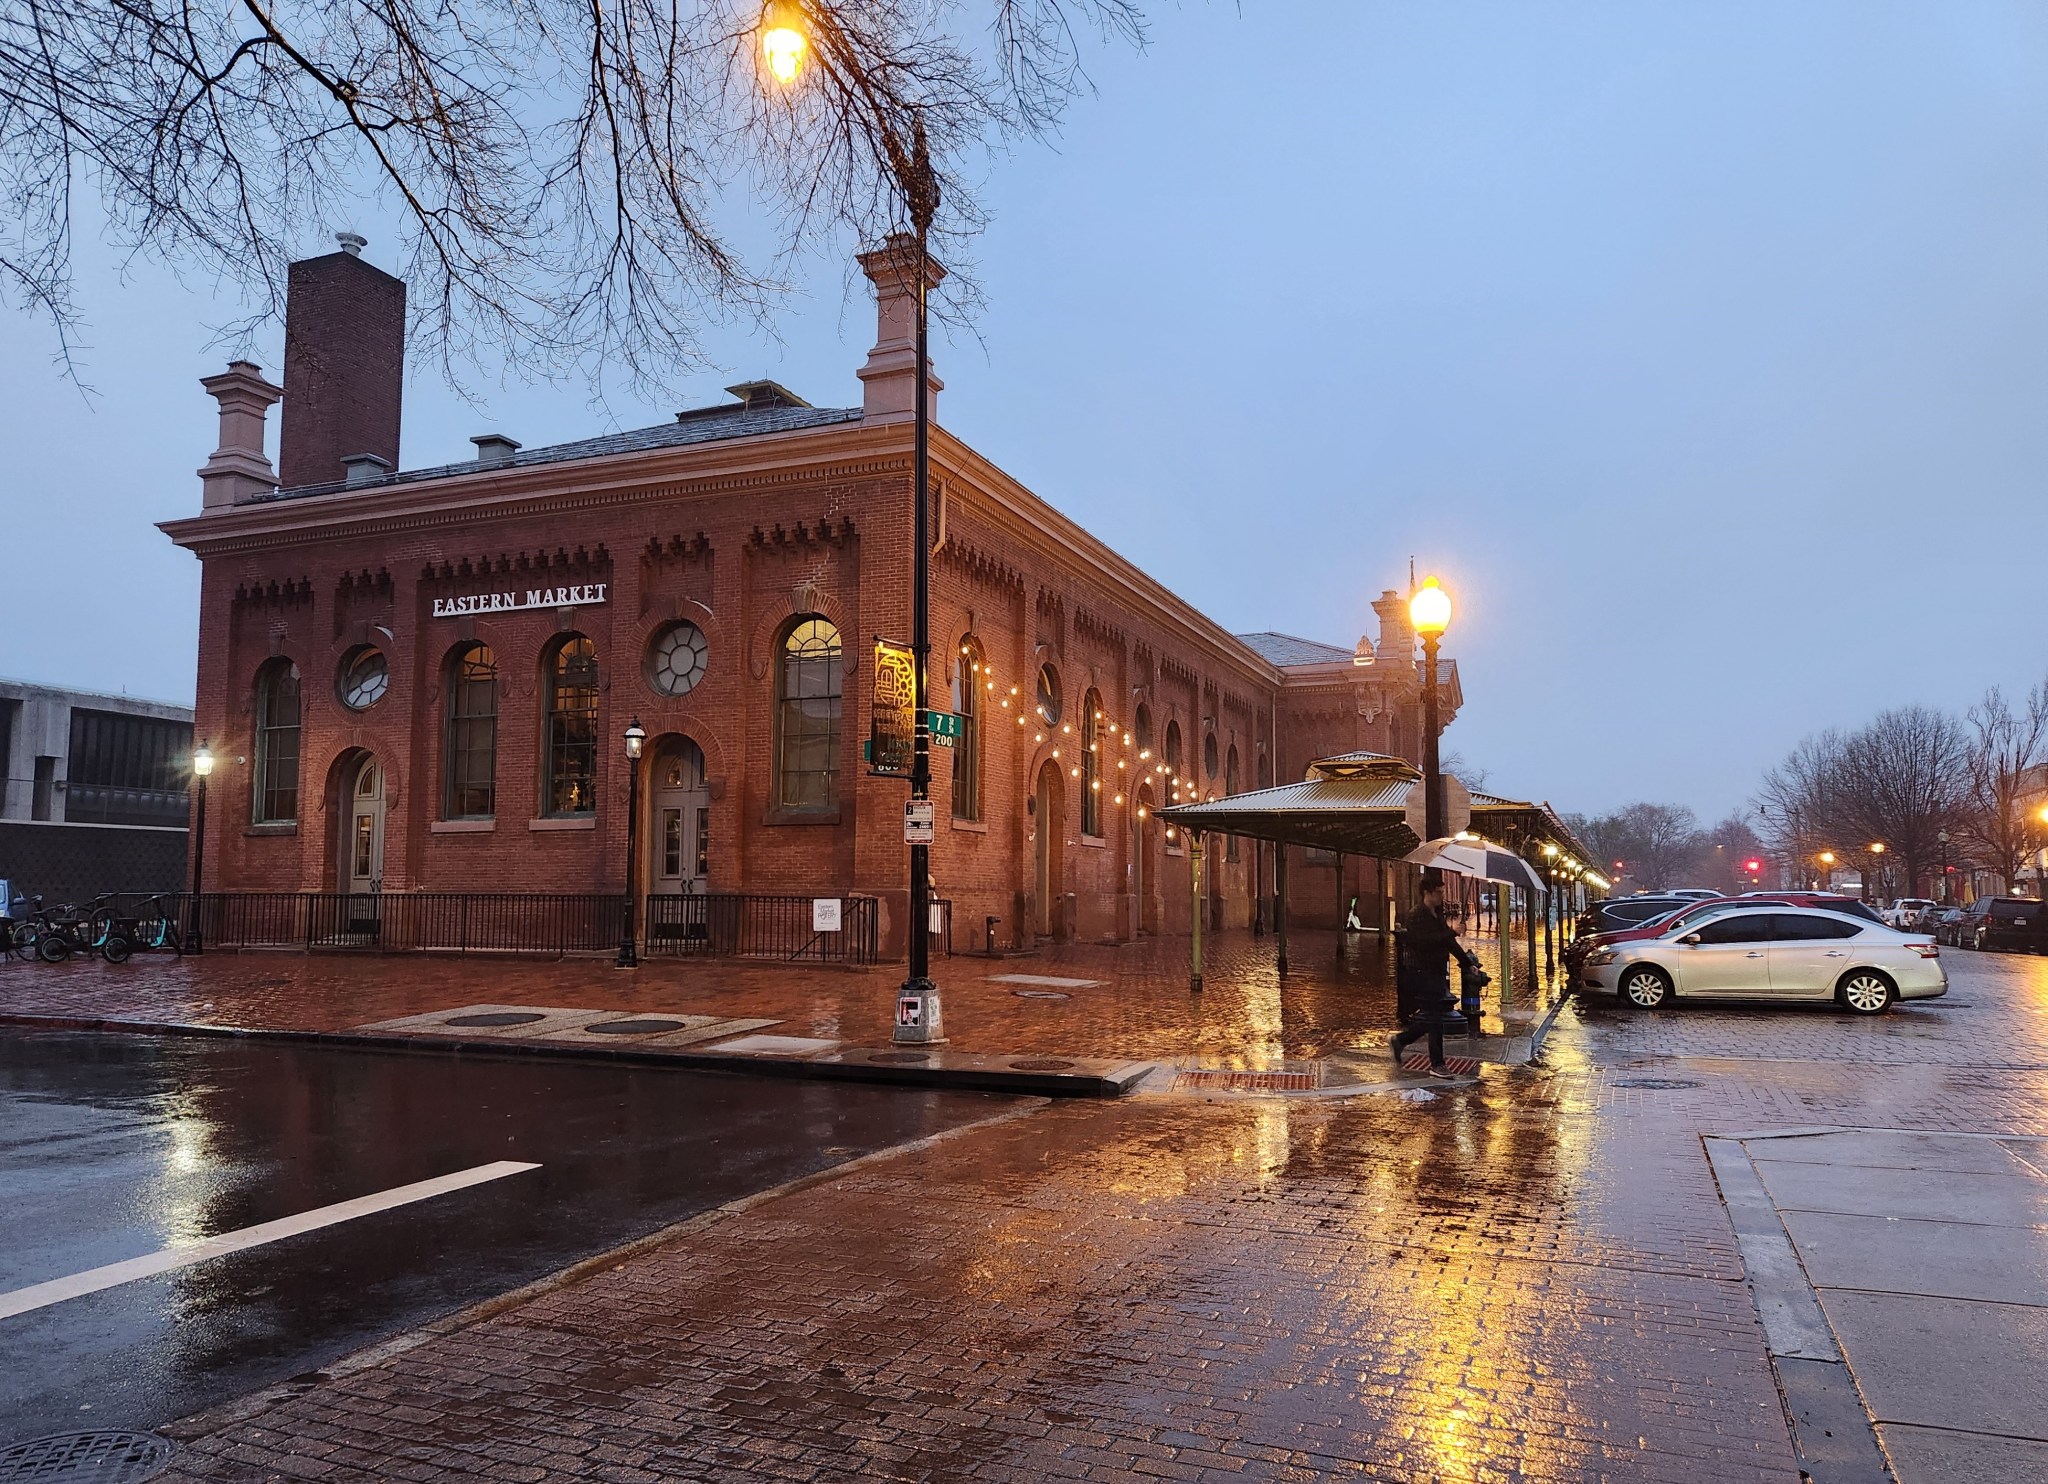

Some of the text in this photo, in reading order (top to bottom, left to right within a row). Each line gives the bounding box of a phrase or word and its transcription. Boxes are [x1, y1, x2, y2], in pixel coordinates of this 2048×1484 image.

[433, 584, 608, 616] EASTERN MARKET
[936, 714, 943, 731] 7
[935, 734, 953, 747] 200
